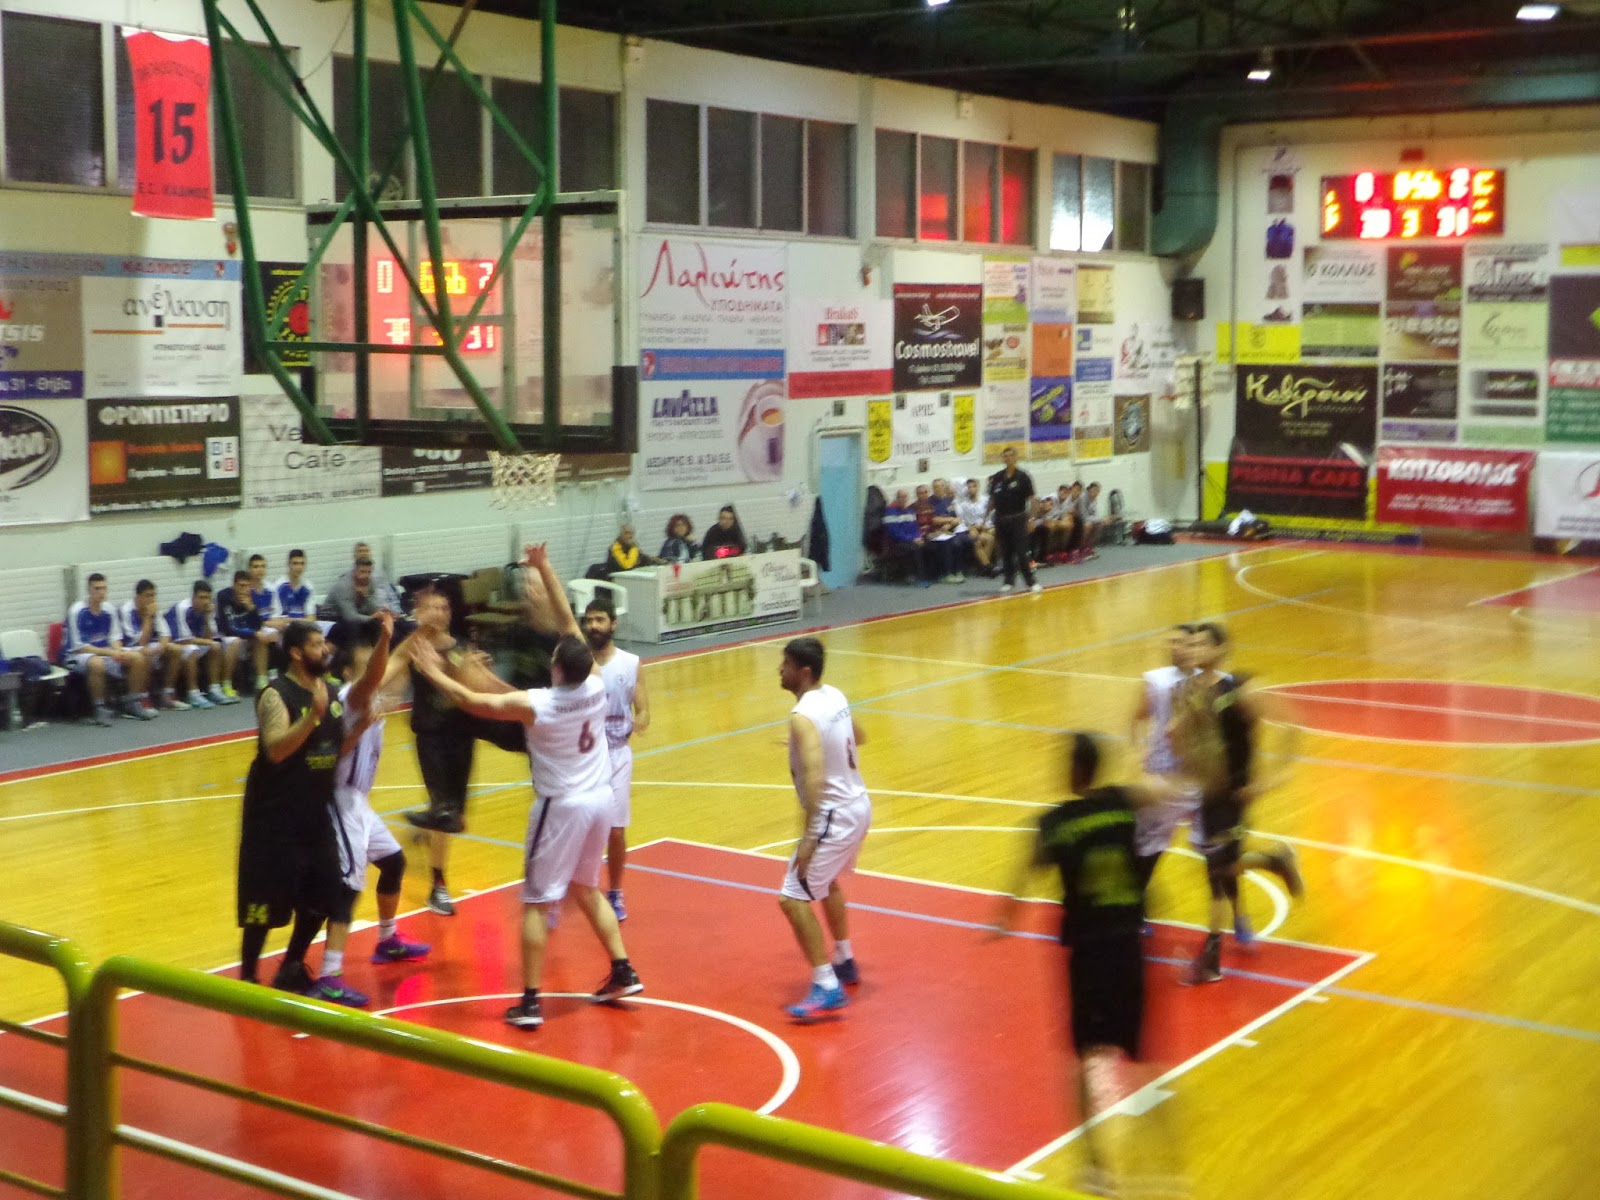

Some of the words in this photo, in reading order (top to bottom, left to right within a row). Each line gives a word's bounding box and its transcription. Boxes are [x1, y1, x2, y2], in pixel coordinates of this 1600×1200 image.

[149, 99, 195, 165] 15
[895, 338, 980, 359] Cosmostravel
[653, 389, 719, 419] LAVAZZA
[285, 450, 346, 470] Cafe
[578, 719, 596, 754] 6
